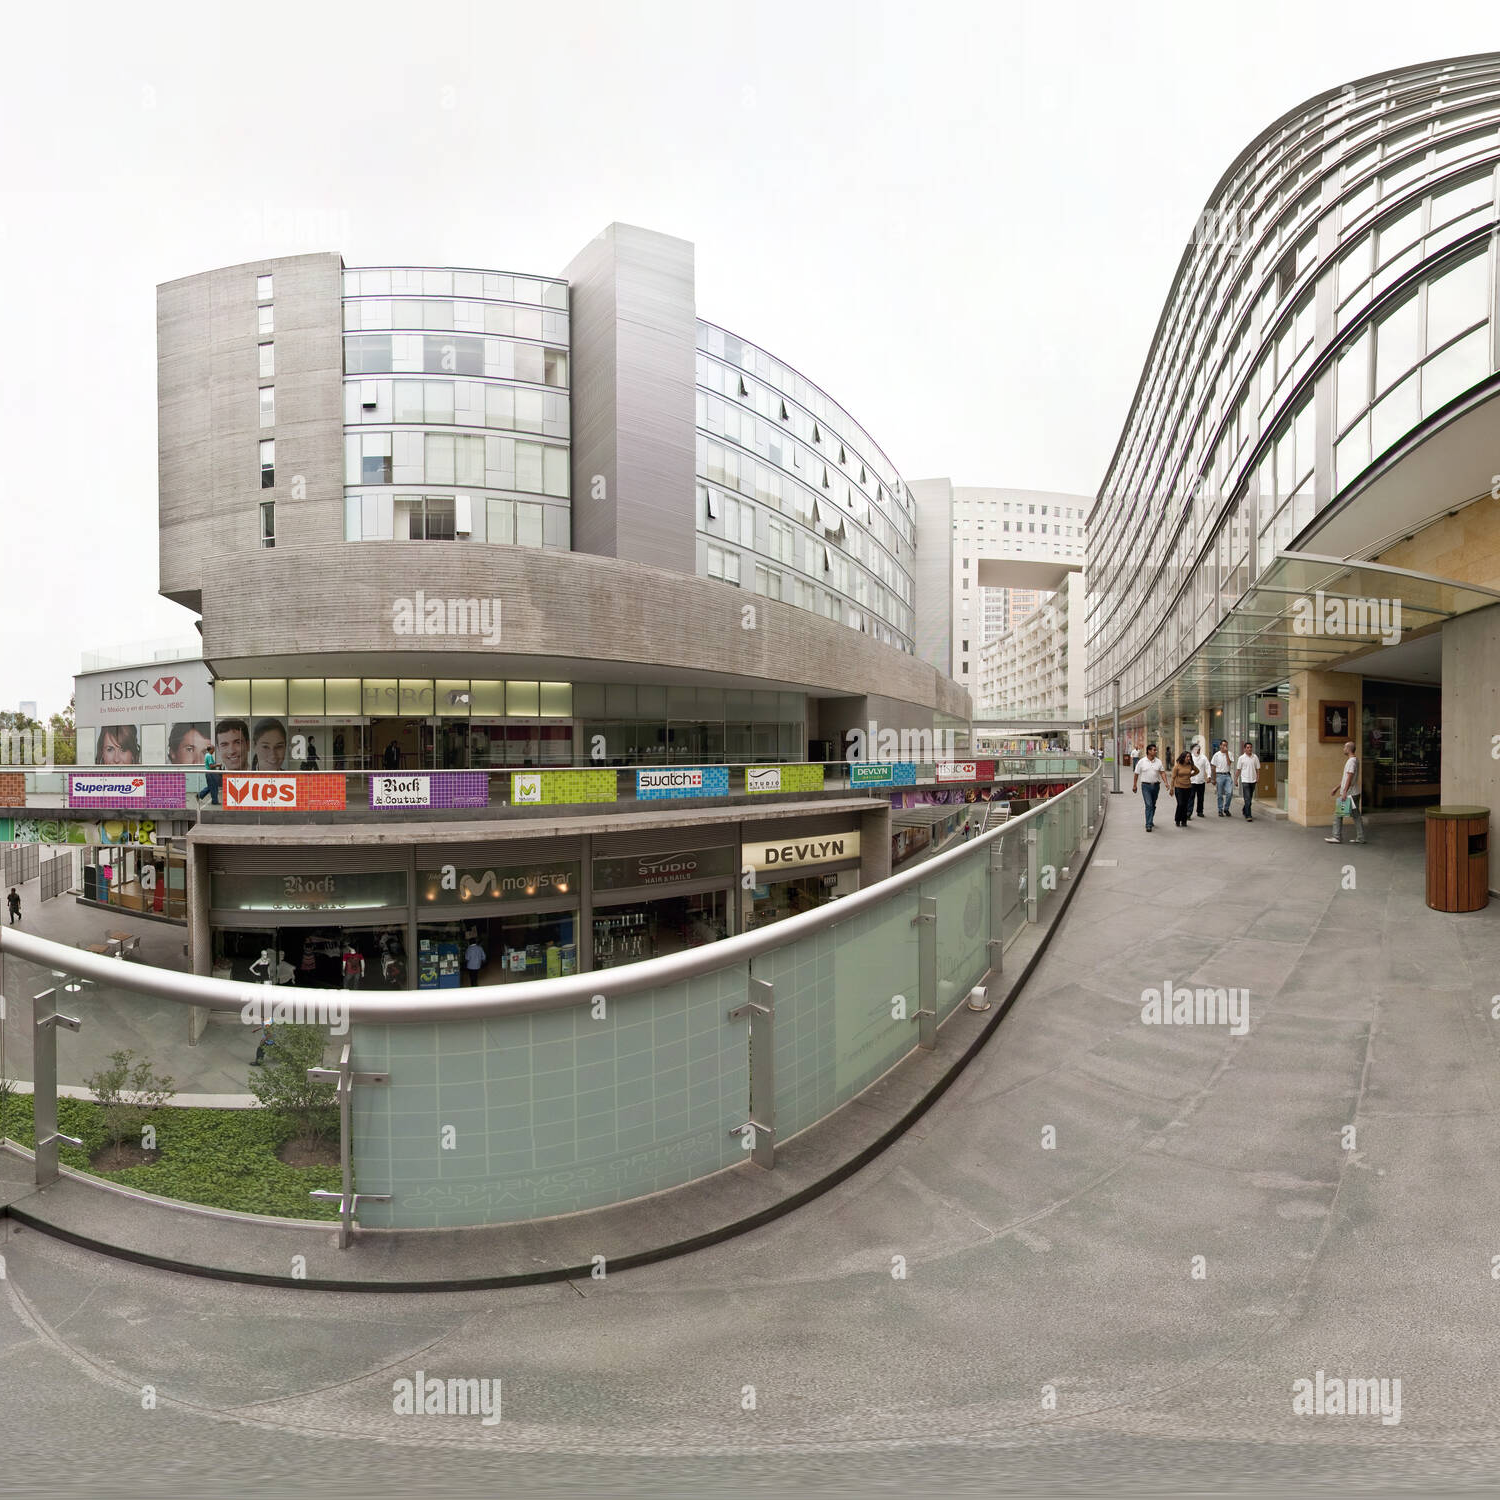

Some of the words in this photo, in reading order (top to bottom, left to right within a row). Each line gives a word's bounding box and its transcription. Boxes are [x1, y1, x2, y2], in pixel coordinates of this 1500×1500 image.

[100, 680, 149, 701] HSBC
[364, 687, 434, 706] HSBC
[857, 767, 888, 776] DEVLYN
[383, 778, 420, 792] Rock
[640, 773, 692, 787] swatch
[74, 782, 132, 794] Superama
[375, 796, 382, 804] &
[386, 796, 428, 804] Couture
[765, 840, 844, 864] DEVLYN
[638, 861, 698, 875] STUDIO
[283, 875, 336, 896] Rock
[502, 872, 573, 890] movistar
